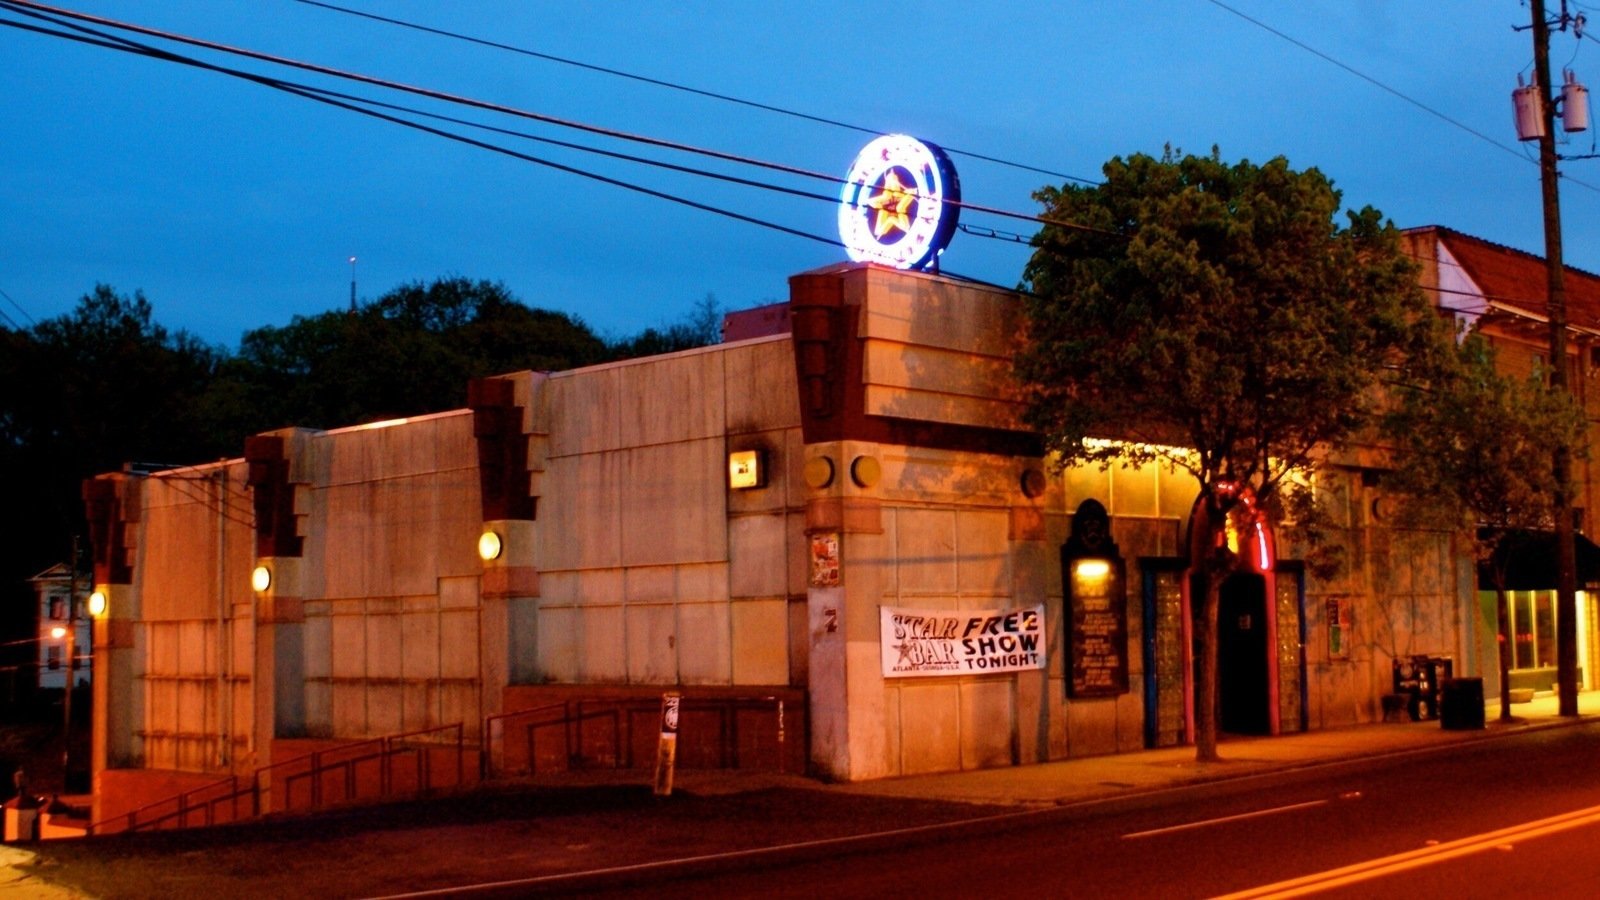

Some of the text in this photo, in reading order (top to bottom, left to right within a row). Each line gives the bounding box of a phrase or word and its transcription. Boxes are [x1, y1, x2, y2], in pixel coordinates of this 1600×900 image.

[891, 615, 959, 640] STAR
[962, 611, 1038, 638] FREE
[908, 640, 959, 666] BAR
[962, 634, 1039, 656] SHOW
[964, 653, 1038, 669] TONIGHT
